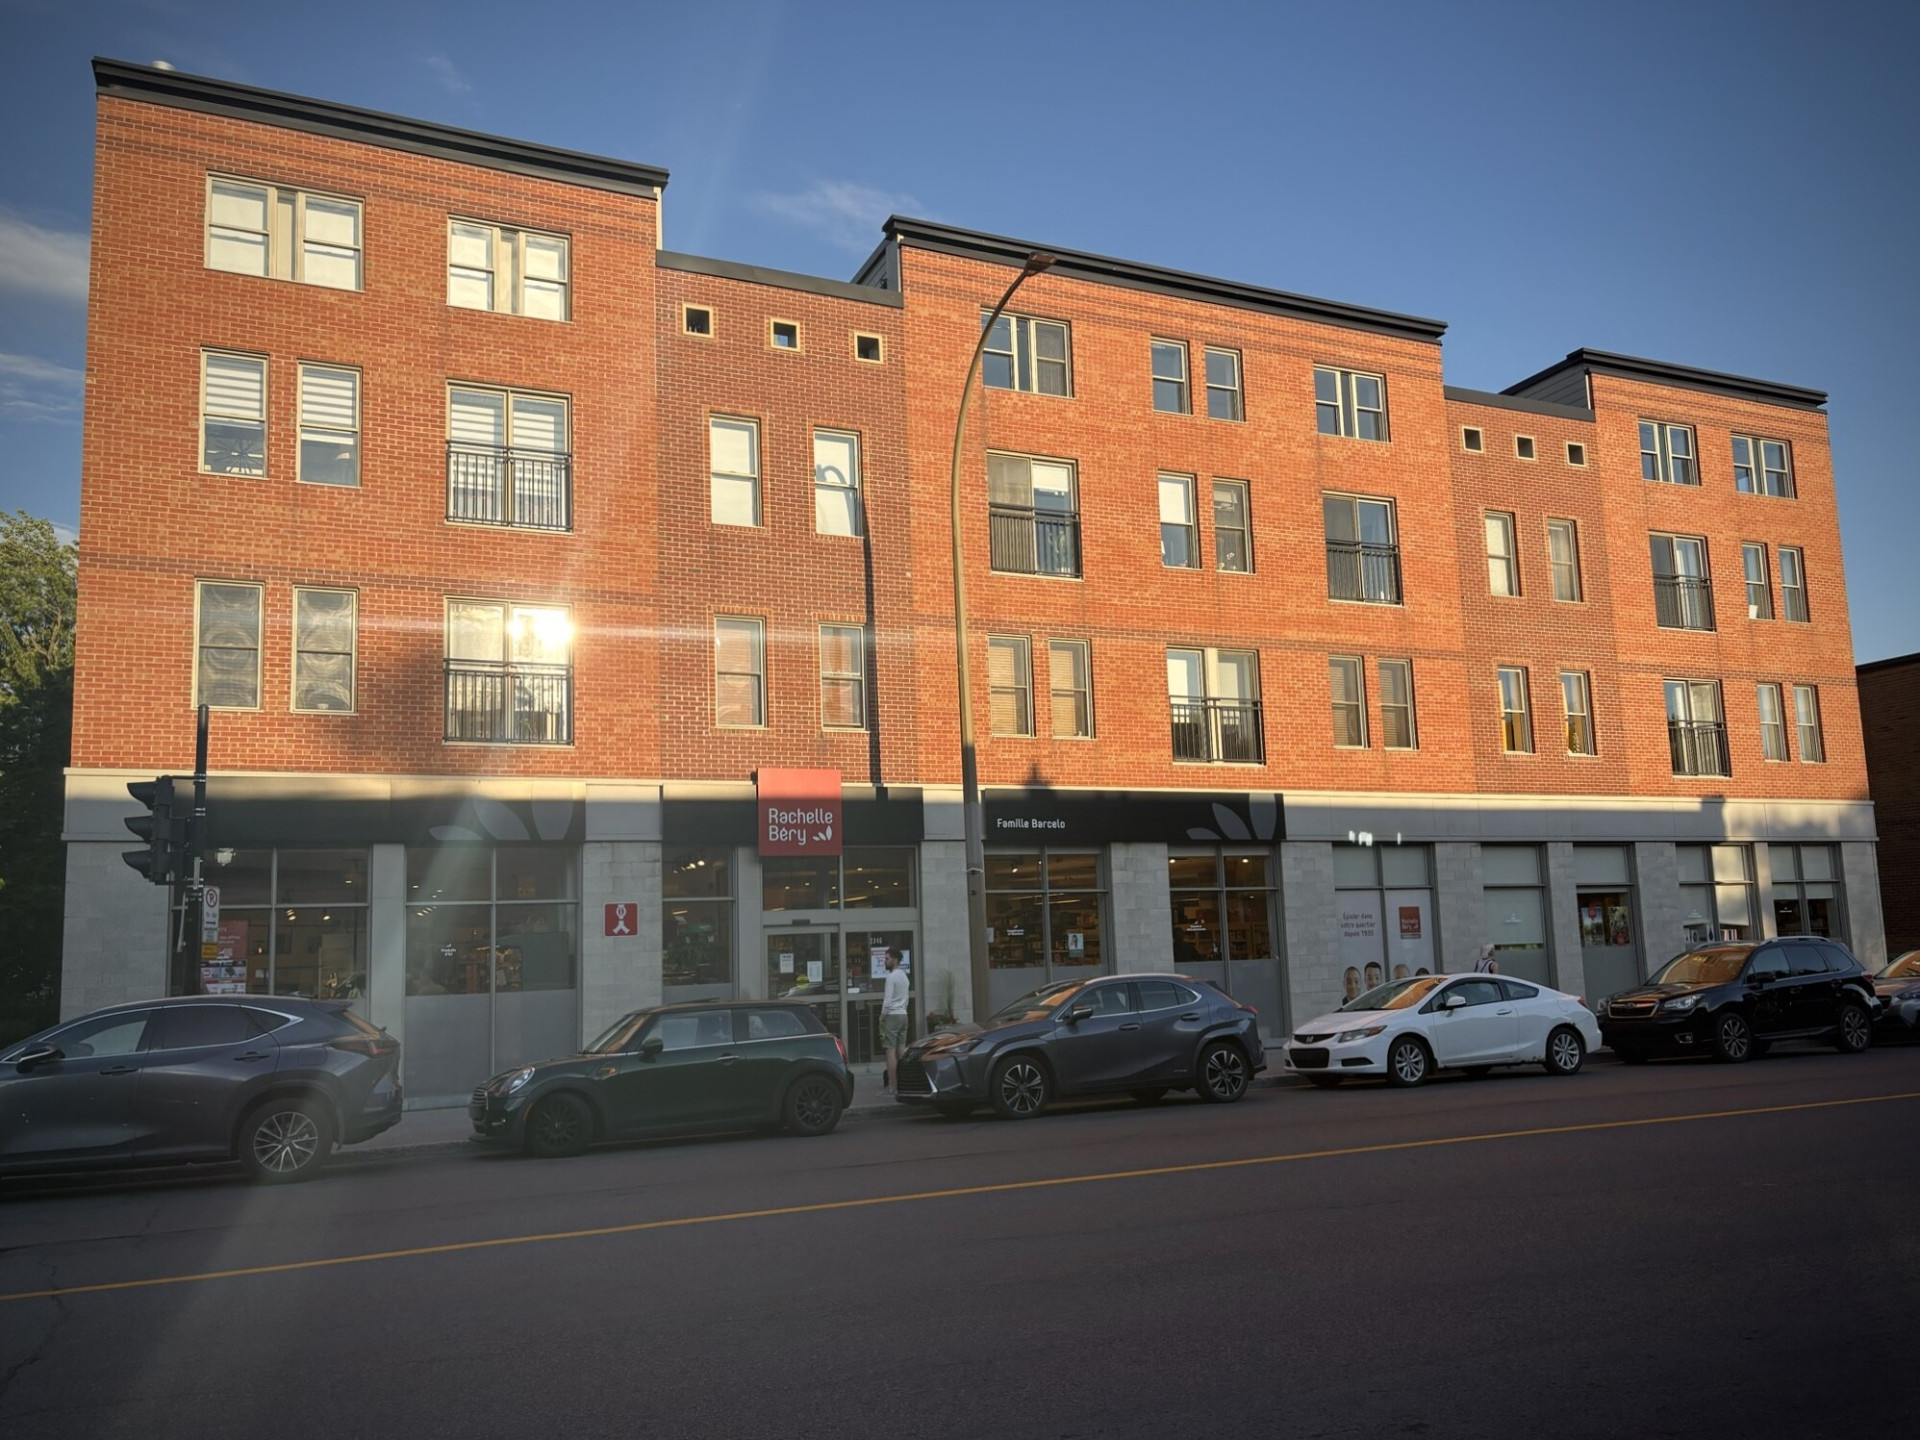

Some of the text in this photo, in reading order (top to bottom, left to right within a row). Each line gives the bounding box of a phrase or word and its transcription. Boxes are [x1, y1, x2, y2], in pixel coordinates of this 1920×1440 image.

[768, 808, 833, 824] Rachelle
[996, 818, 1066, 829] Famille Barcelo
[768, 825, 807, 846] Béry
